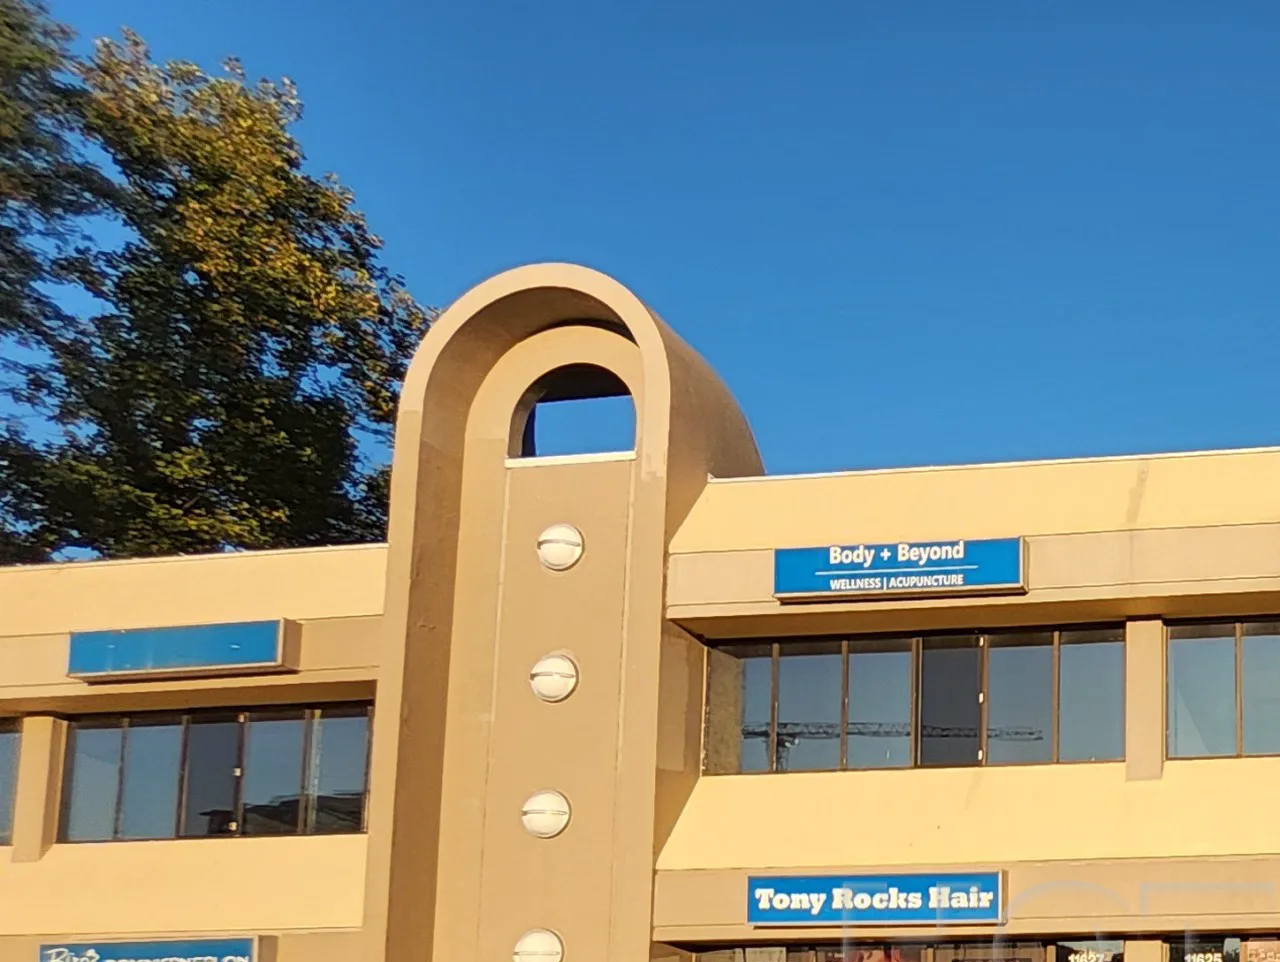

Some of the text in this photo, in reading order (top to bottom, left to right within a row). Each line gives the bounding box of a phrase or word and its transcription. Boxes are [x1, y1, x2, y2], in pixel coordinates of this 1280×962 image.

[829, 545, 875, 568] Body
[896, 540, 965, 568] Beyond
[829, 578, 881, 591] WELLNESS
[889, 574, 964, 588] ACUPUNCTURE
[755, 885, 996, 915] Tony Rocks Hair
